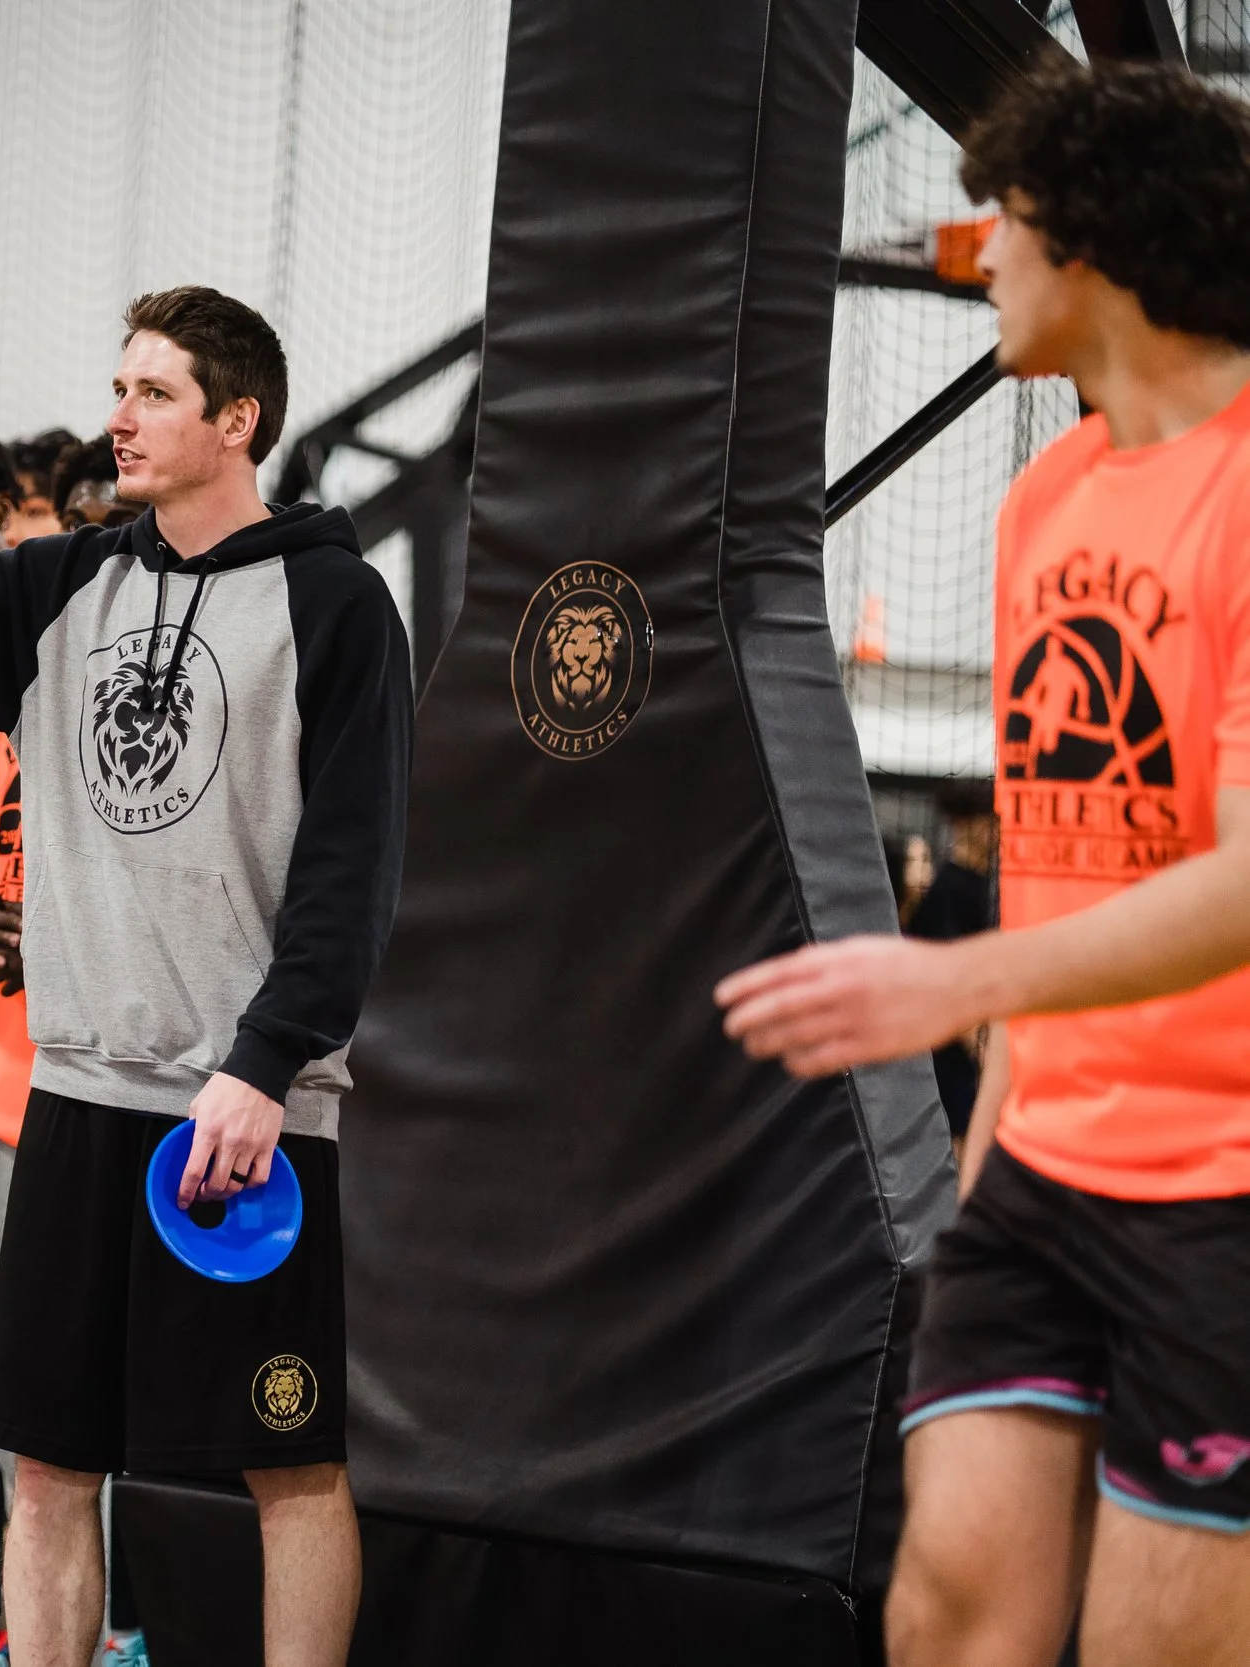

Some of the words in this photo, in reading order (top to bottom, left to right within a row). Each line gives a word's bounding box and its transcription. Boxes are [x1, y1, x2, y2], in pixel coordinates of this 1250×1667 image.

[549, 568, 626, 599] LEGACY
[116, 633, 202, 664] LEGAY
[527, 710, 628, 753] ATHLETICS
[90, 780, 190, 824] ATHLETICS
[268, 1358, 302, 1370] LEGACY
[263, 1411, 306, 1427] ATHLETICS
